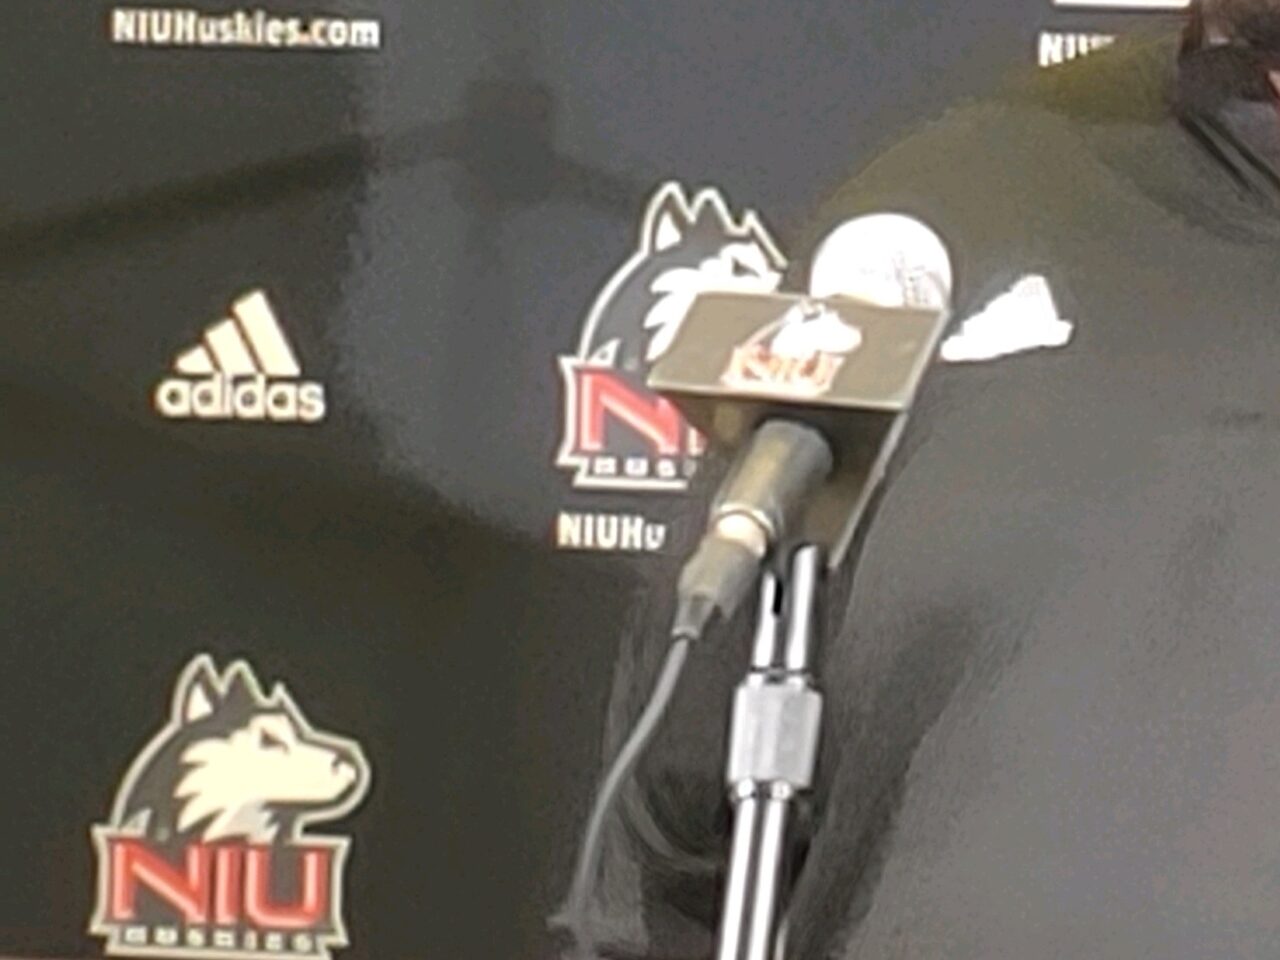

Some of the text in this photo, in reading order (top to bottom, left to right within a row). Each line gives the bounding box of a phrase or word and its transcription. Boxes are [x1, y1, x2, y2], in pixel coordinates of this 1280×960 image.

[112, 7, 382, 49] NIUHuskies.com
[156, 372, 326, 424] adidas
[112, 837, 331, 928] NIU
